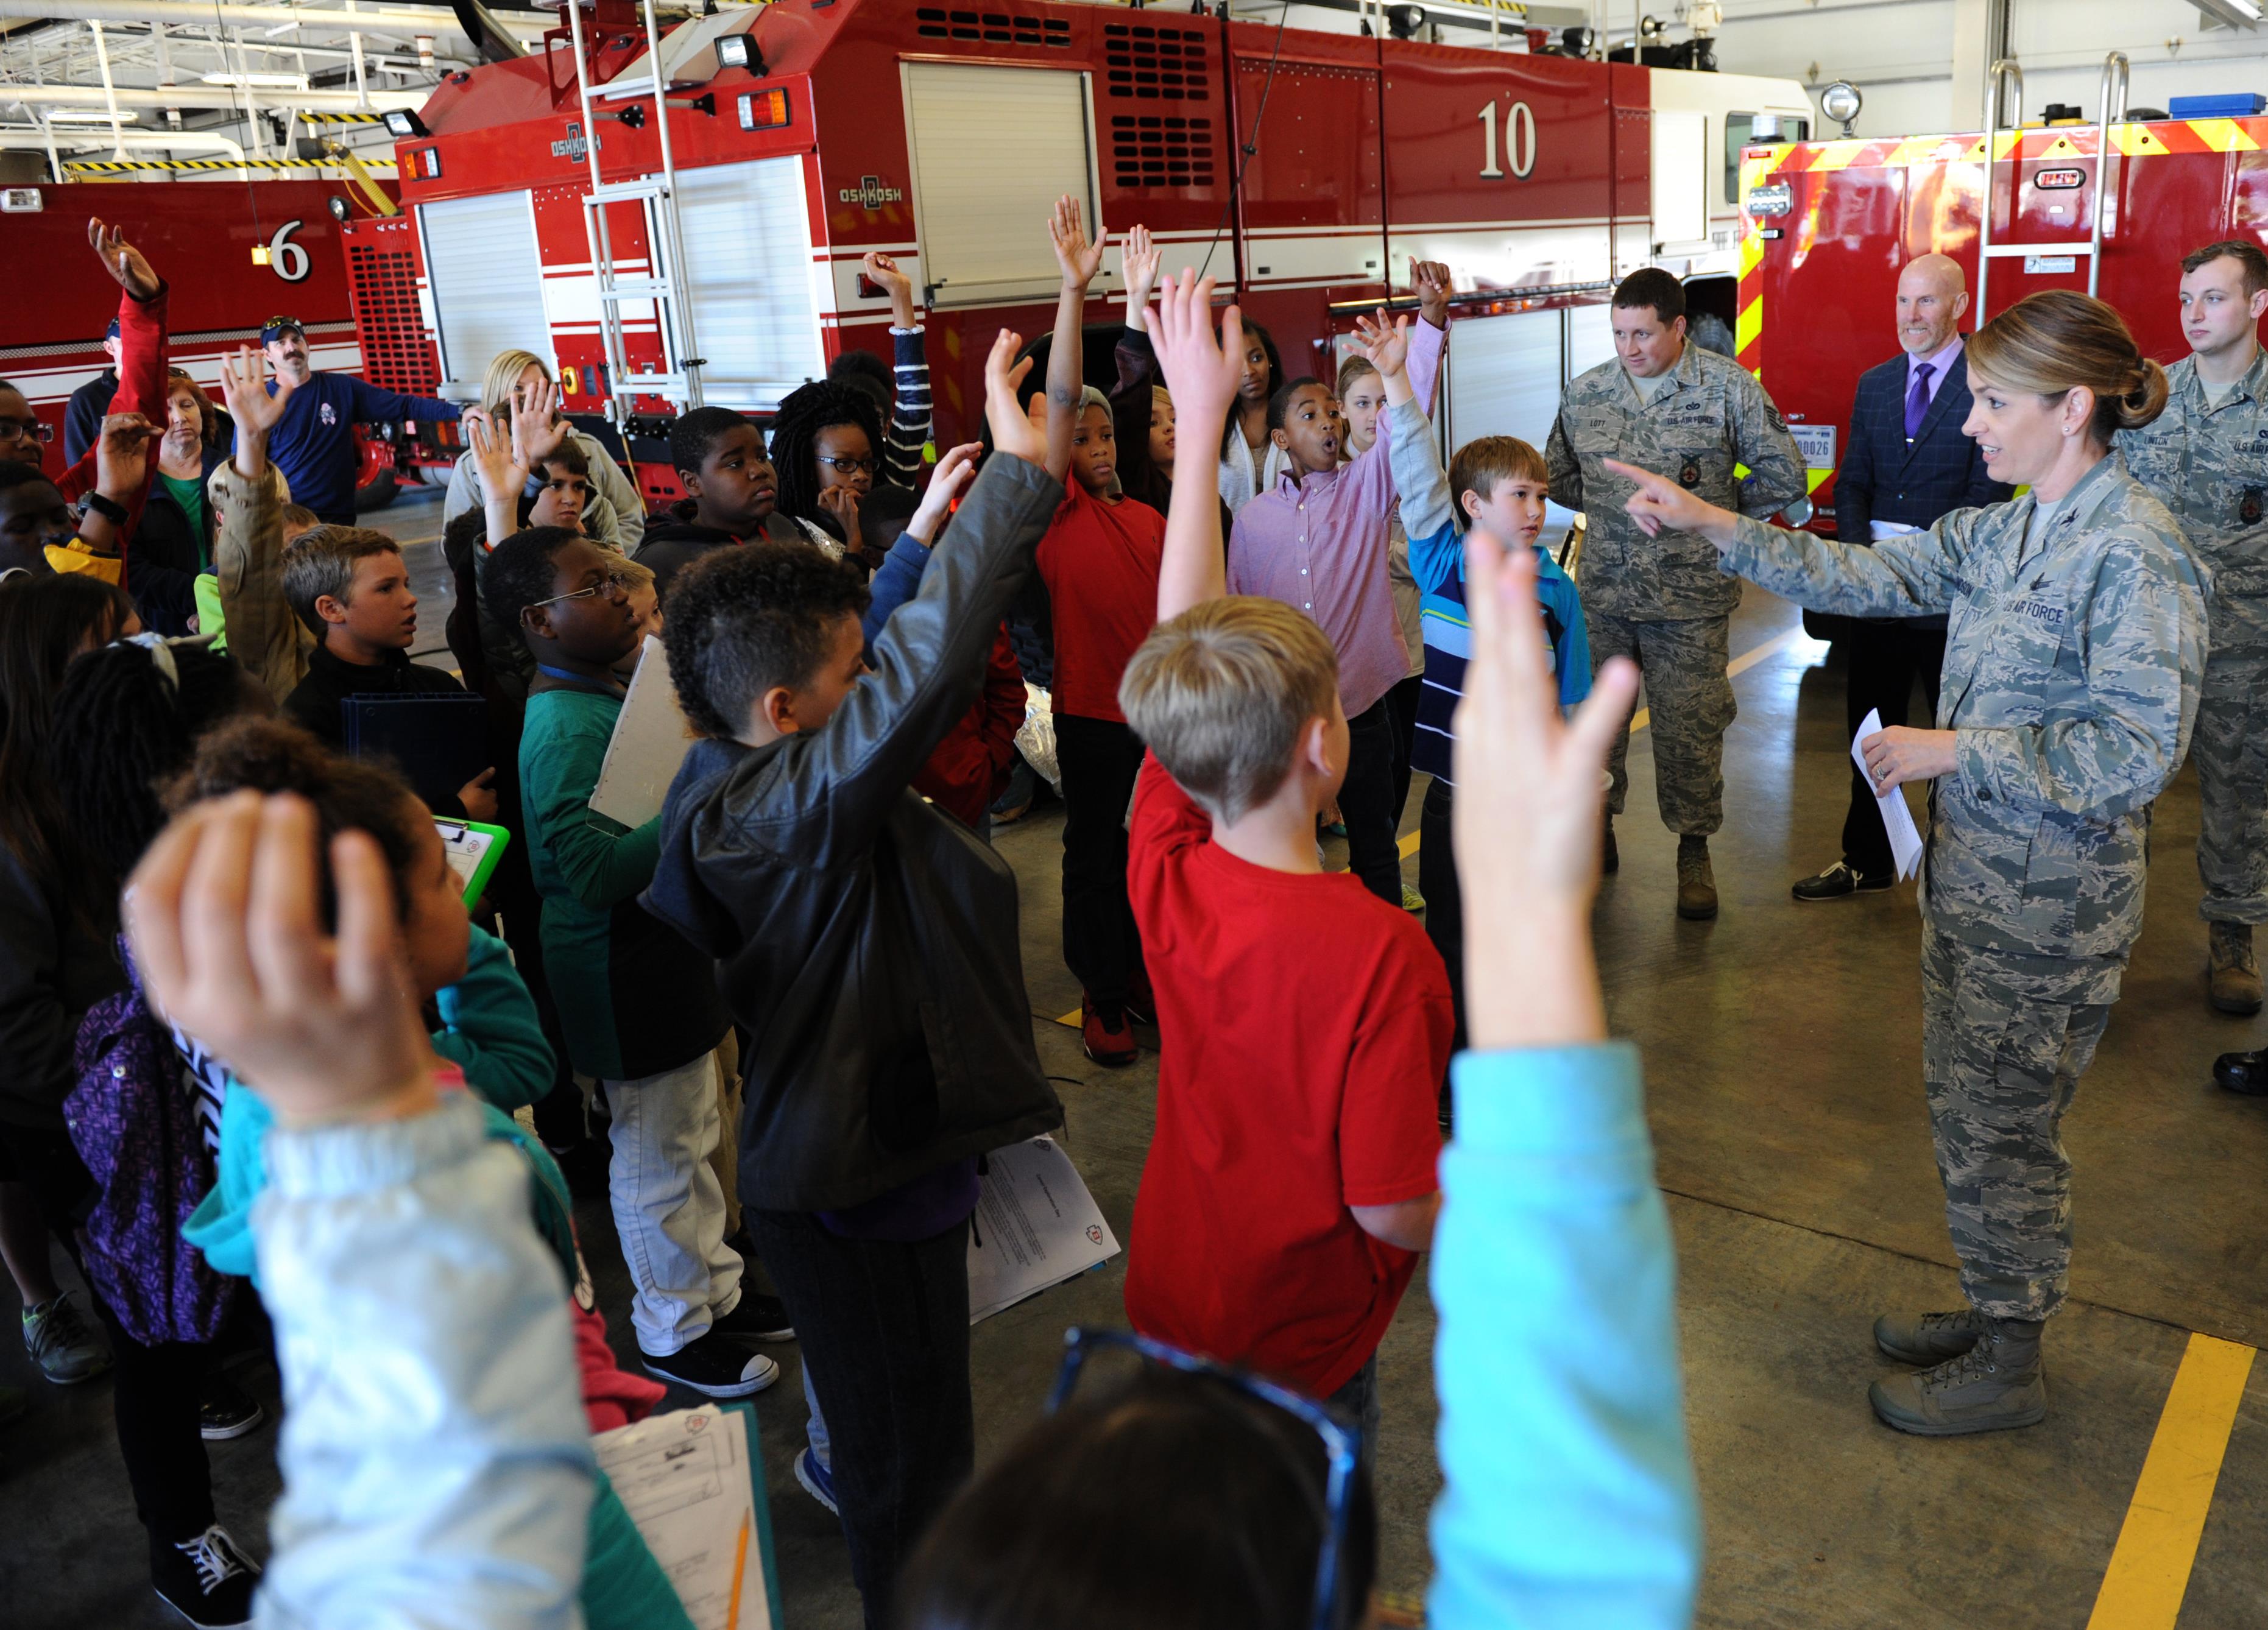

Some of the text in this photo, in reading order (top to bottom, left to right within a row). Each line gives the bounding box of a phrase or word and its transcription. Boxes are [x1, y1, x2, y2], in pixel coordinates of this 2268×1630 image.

[550, 134, 602, 157] OSHKOH
[1478, 100, 1537, 178] 10
[839, 188, 902, 203] OSHKOSH
[270, 220, 310, 282] 6
[1694, 415, 1715, 425] FORCE
[2144, 435, 2169, 446] LINTON
[2234, 442, 2248, 453] U.S.
[2250, 443, 2264, 454] AIR
[2012, 600, 2027, 614] AIR
[2026, 602, 2064, 624] FORCE
